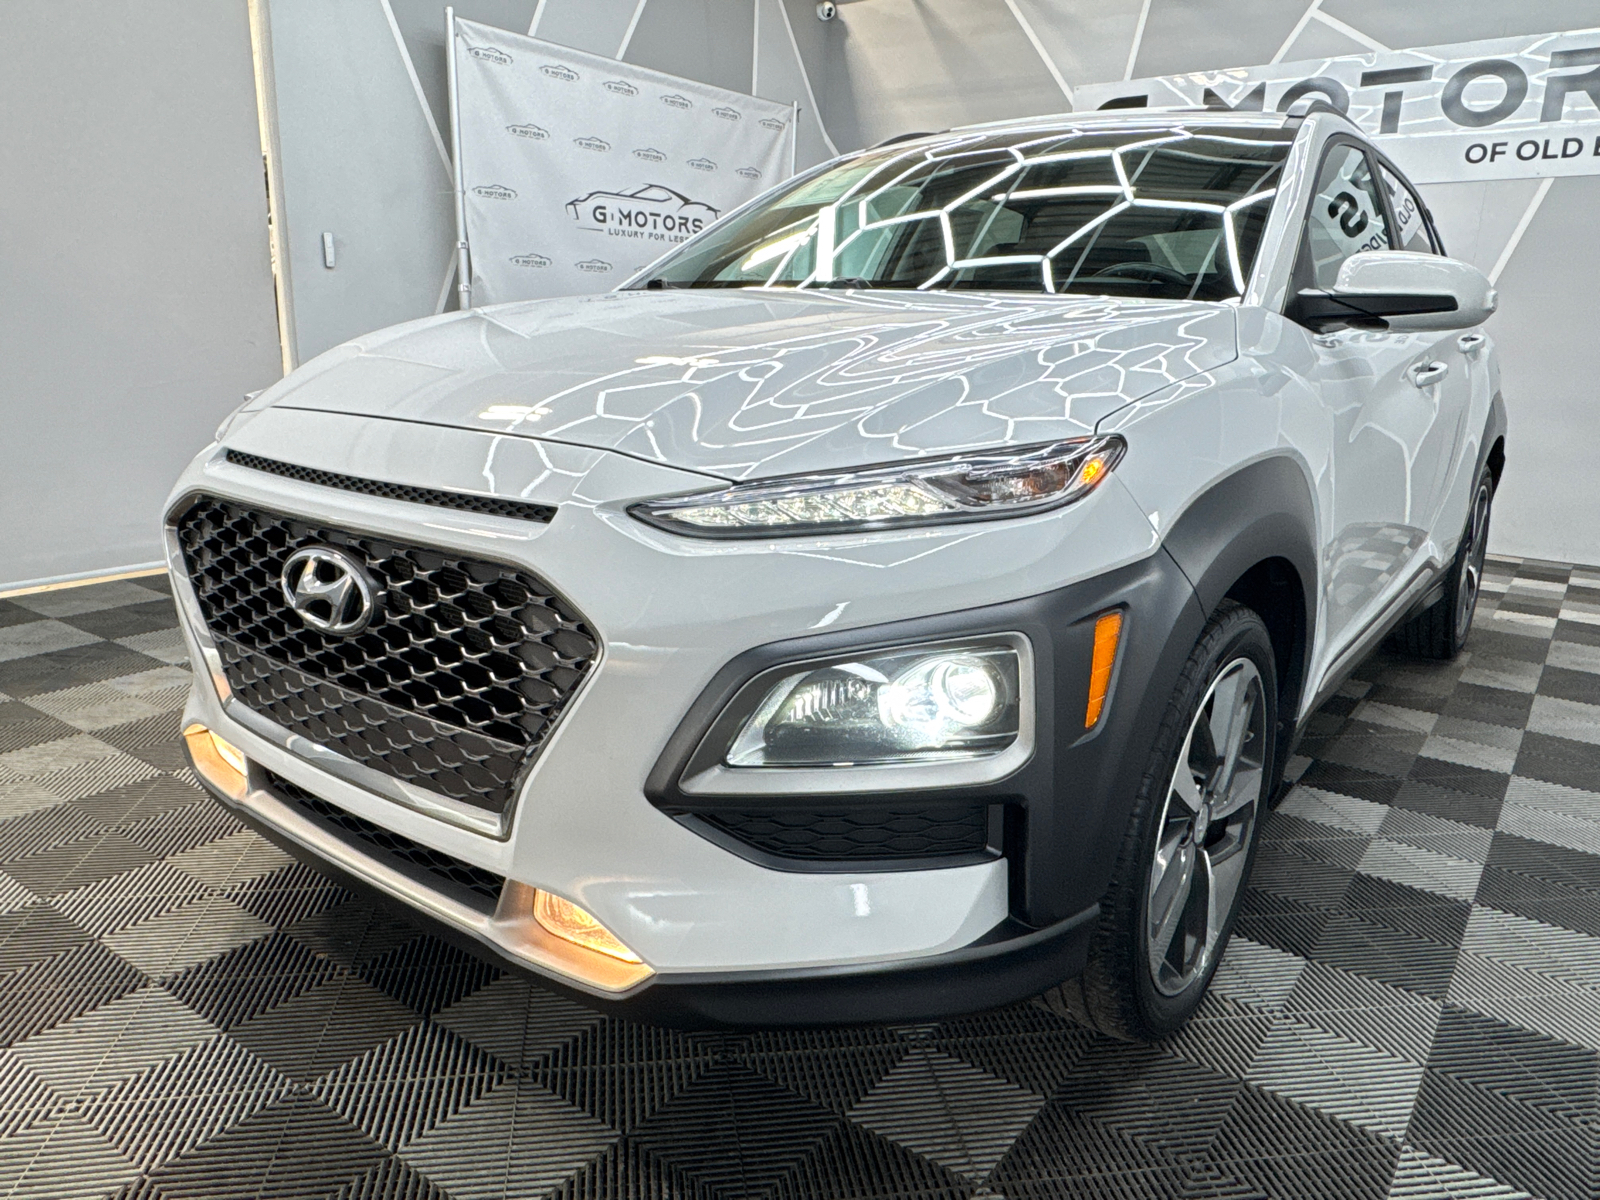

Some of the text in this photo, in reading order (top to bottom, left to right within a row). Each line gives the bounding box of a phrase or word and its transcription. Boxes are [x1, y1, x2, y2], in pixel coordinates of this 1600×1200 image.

[1465, 142, 1508, 164] OF
[1516, 137, 1583, 161] OLD
[484, 190, 511, 198] MOTORS
[592, 205, 704, 234] G MOTORS
[608, 227, 645, 239] LUXURY
[648, 232, 665, 241] FOR
